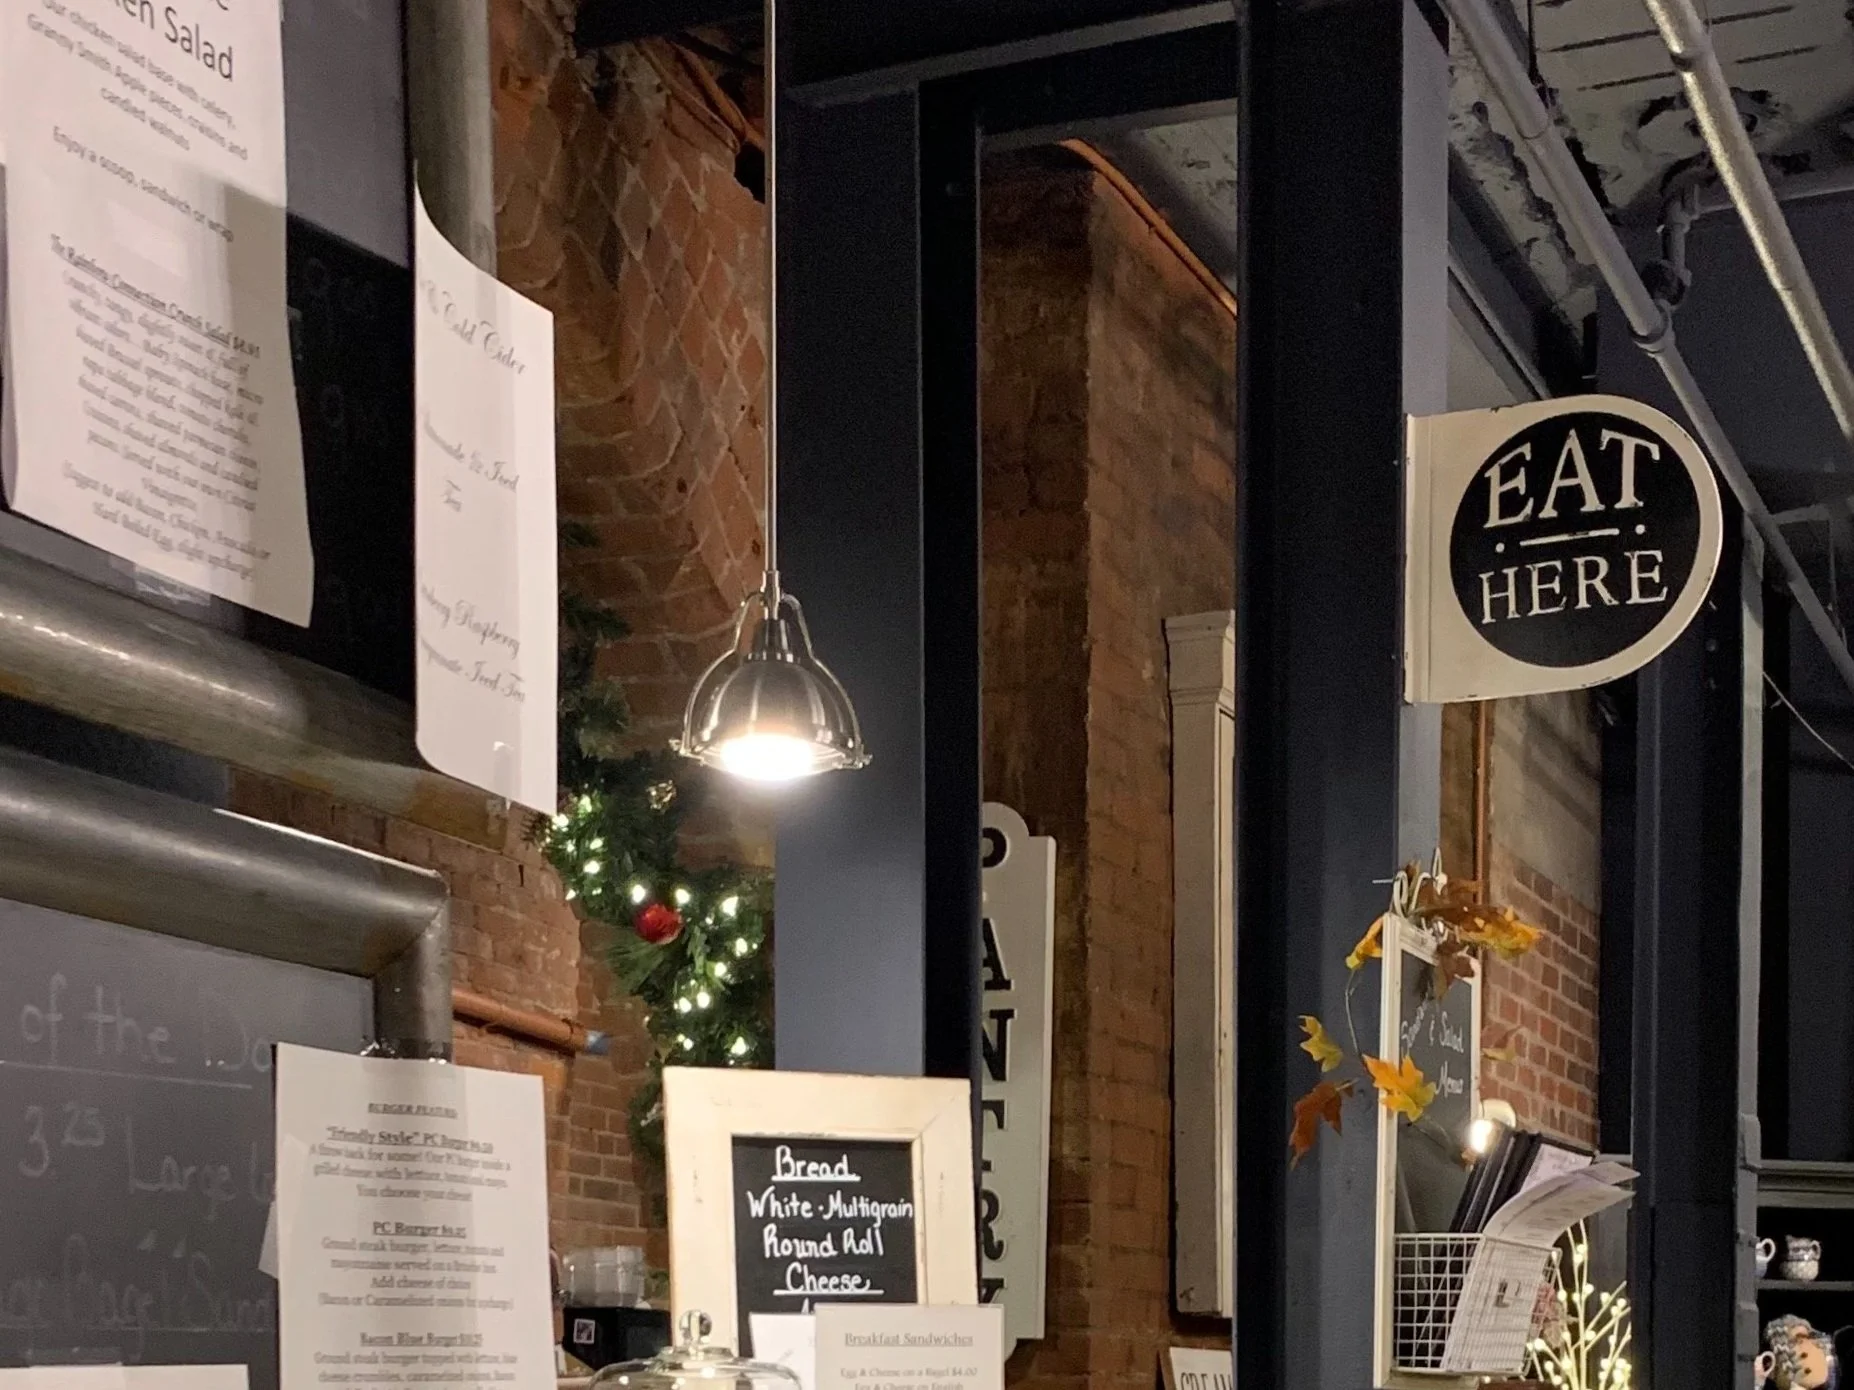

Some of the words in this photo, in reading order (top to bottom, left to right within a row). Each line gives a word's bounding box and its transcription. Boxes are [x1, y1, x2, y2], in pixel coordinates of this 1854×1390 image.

[164, 6, 233, 82] Salad
[1483, 427, 1661, 529] EAT
[1478, 549, 1669, 625] HERE
[20, 971, 68, 1064] of
[83, 984, 177, 1068] the
[773, 1144, 857, 1179] Bread
[746, 1185, 814, 1219] White
[822, 1189, 914, 1228] Multigrain
[372, 1220, 392, 1236] PC
[394, 1221, 440, 1238] Burger
[762, 1222, 839, 1259] Round
[843, 1226, 885, 1257] Roll
[785, 1261, 872, 1293] Cheese
[843, 1332, 900, 1348] Breakfast
[902, 1332, 974, 1348] Sandwiches
[869, 1367, 901, 1378] Cheese
